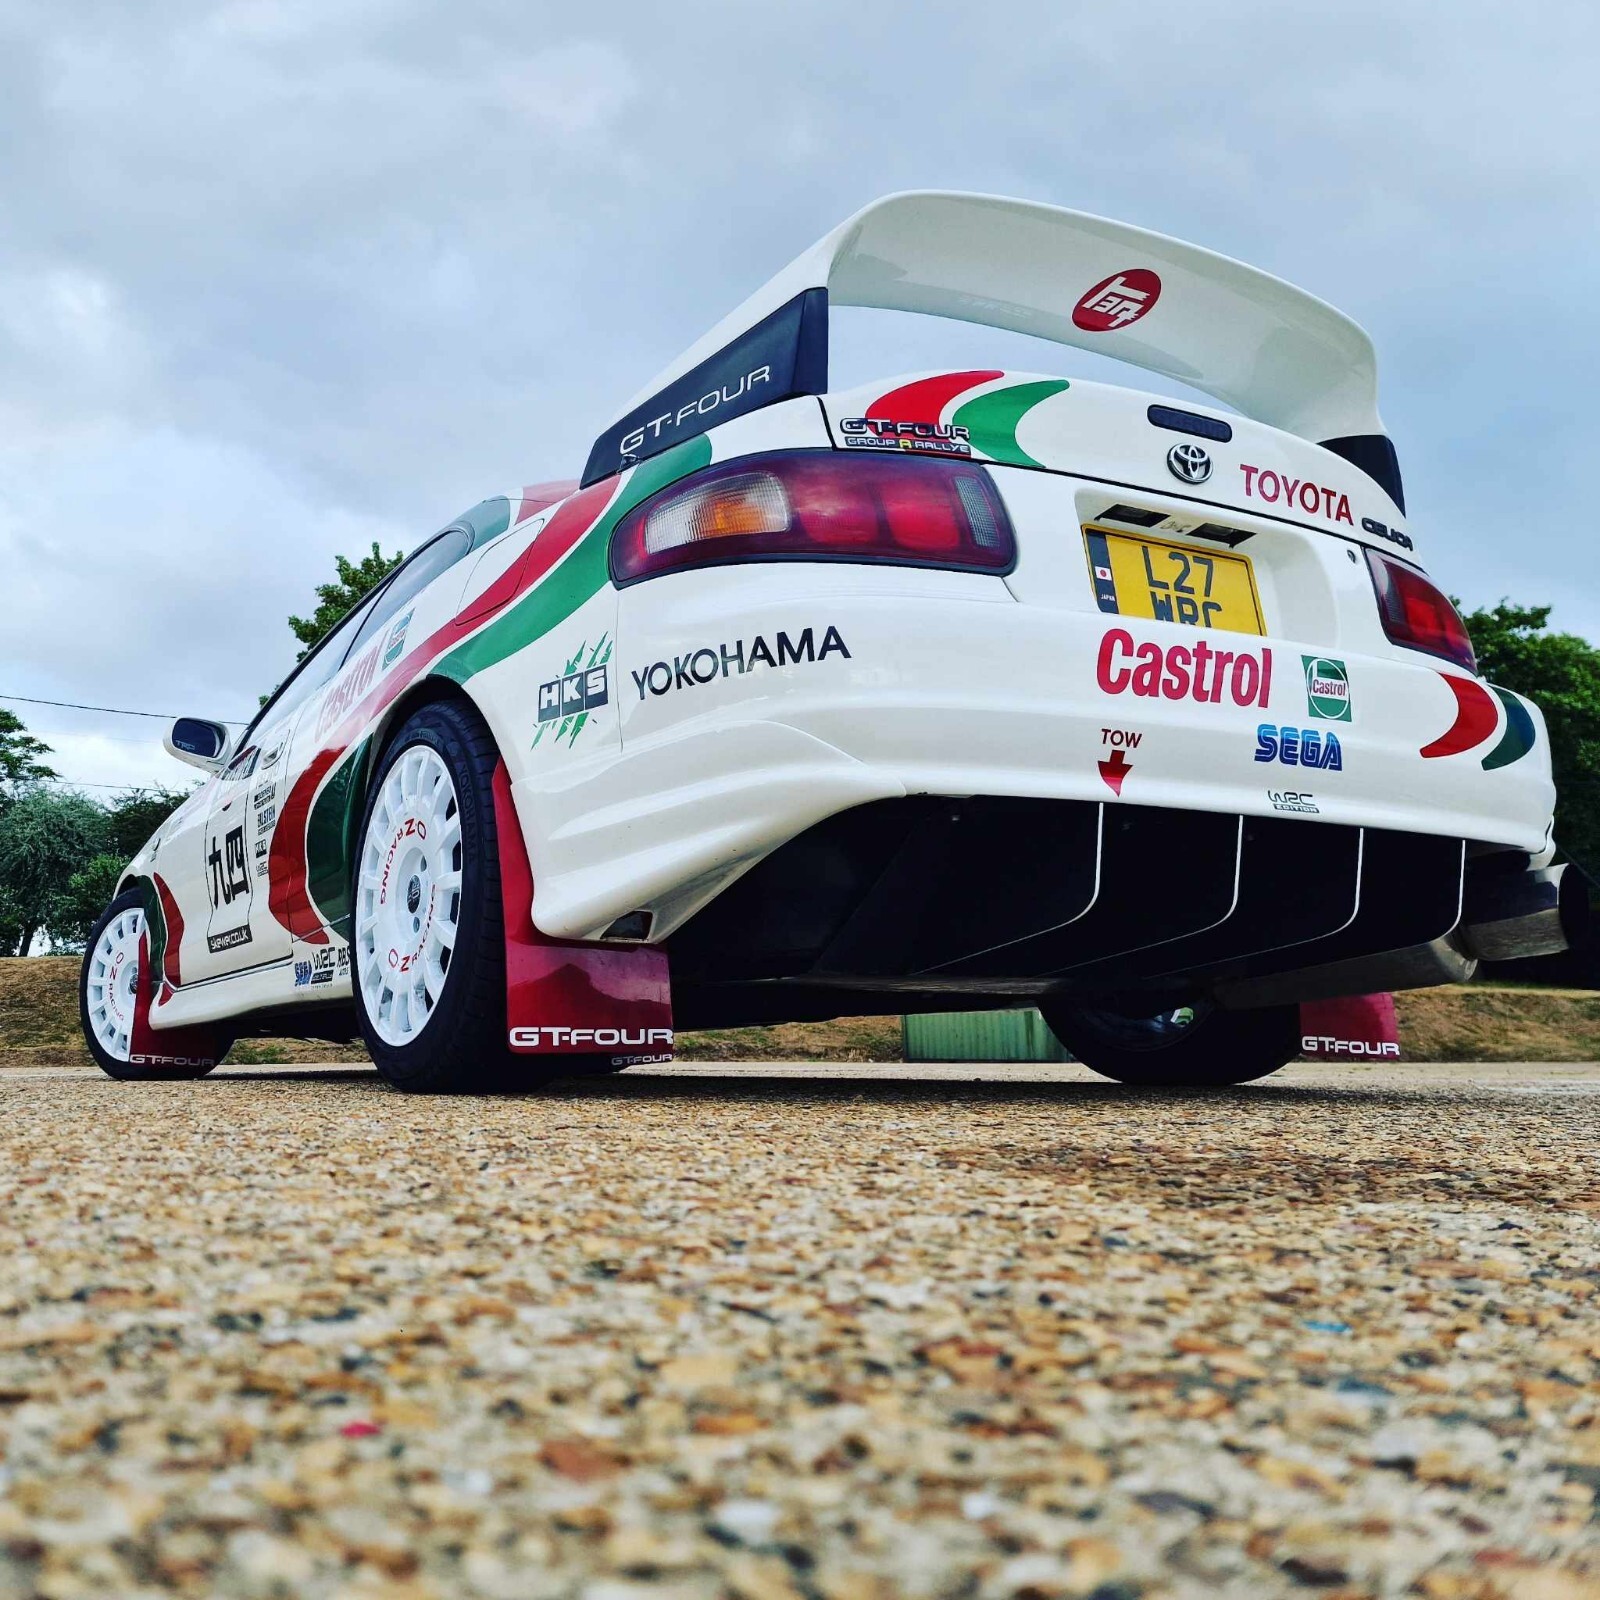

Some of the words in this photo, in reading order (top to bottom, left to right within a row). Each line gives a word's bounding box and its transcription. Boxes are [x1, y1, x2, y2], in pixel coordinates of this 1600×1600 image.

[847, 437, 896, 447] GROUP
[899, 438, 913, 449] A
[914, 440, 971, 453] RALLYE
[1240, 463, 1354, 526] TOYOTA
[1361, 517, 1413, 551] CELICA
[1141, 545, 1214, 598] L27
[1101, 594, 1116, 602] JAPAN
[1150, 591, 1223, 628] WRC
[631, 625, 852, 700] YOKOHAMA
[1097, 628, 1272, 708] Castrol
[314, 629, 391, 743] Castrol
[540, 667, 606, 710] HKS
[1312, 678, 1346, 698] Castrol
[175, 739, 196, 751] TRD
[1101, 728, 1142, 748] TOW
[1254, 723, 1343, 771] SEGA
[461, 763, 479, 863] YOKOHAMA
[1267, 789, 1317, 807] WRC
[1274, 803, 1320, 814] EDITION
[380, 829, 405, 904] RACING
[311, 946, 336, 970] WRC
